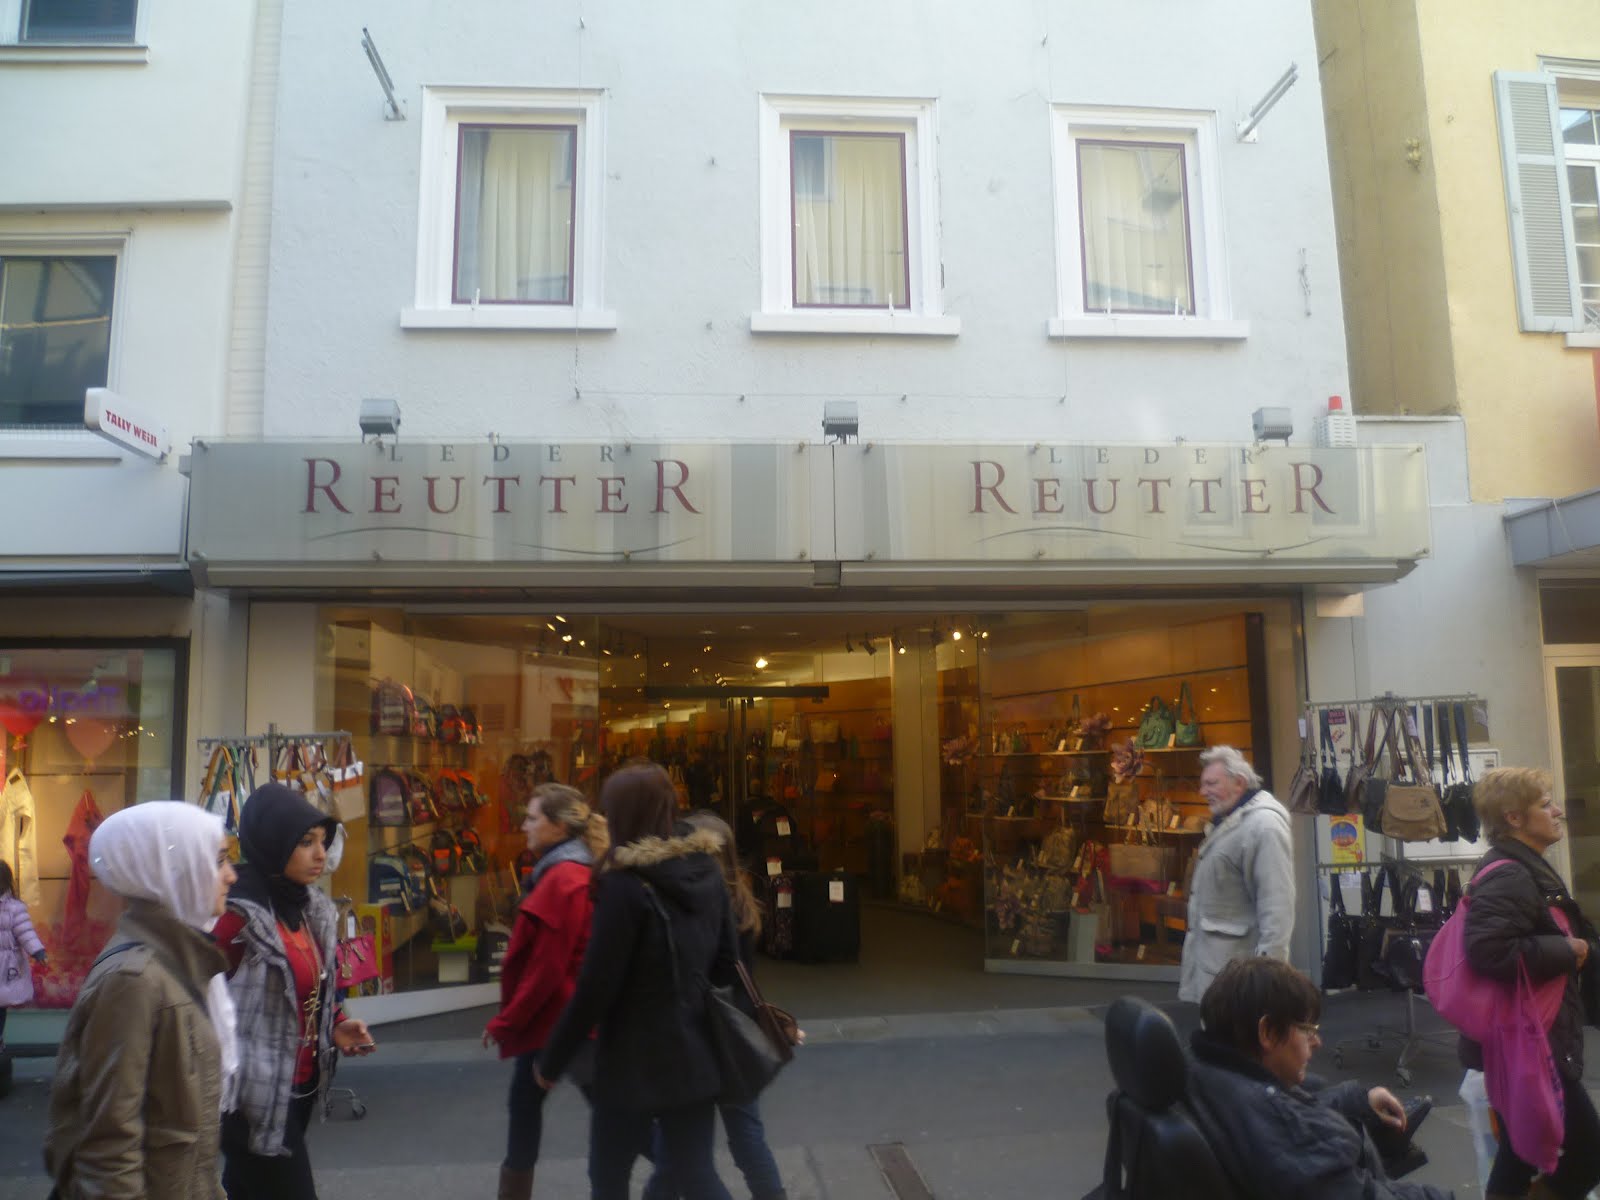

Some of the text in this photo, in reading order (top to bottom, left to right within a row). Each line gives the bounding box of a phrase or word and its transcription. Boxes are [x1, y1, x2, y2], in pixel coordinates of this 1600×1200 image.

[105, 410, 132, 433] TALLY
[390, 444, 615, 462] LEDER
[1048, 447, 1254, 464] LEDER
[302, 457, 702, 514] REUTTER
[968, 460, 1337, 514] REUTTER
